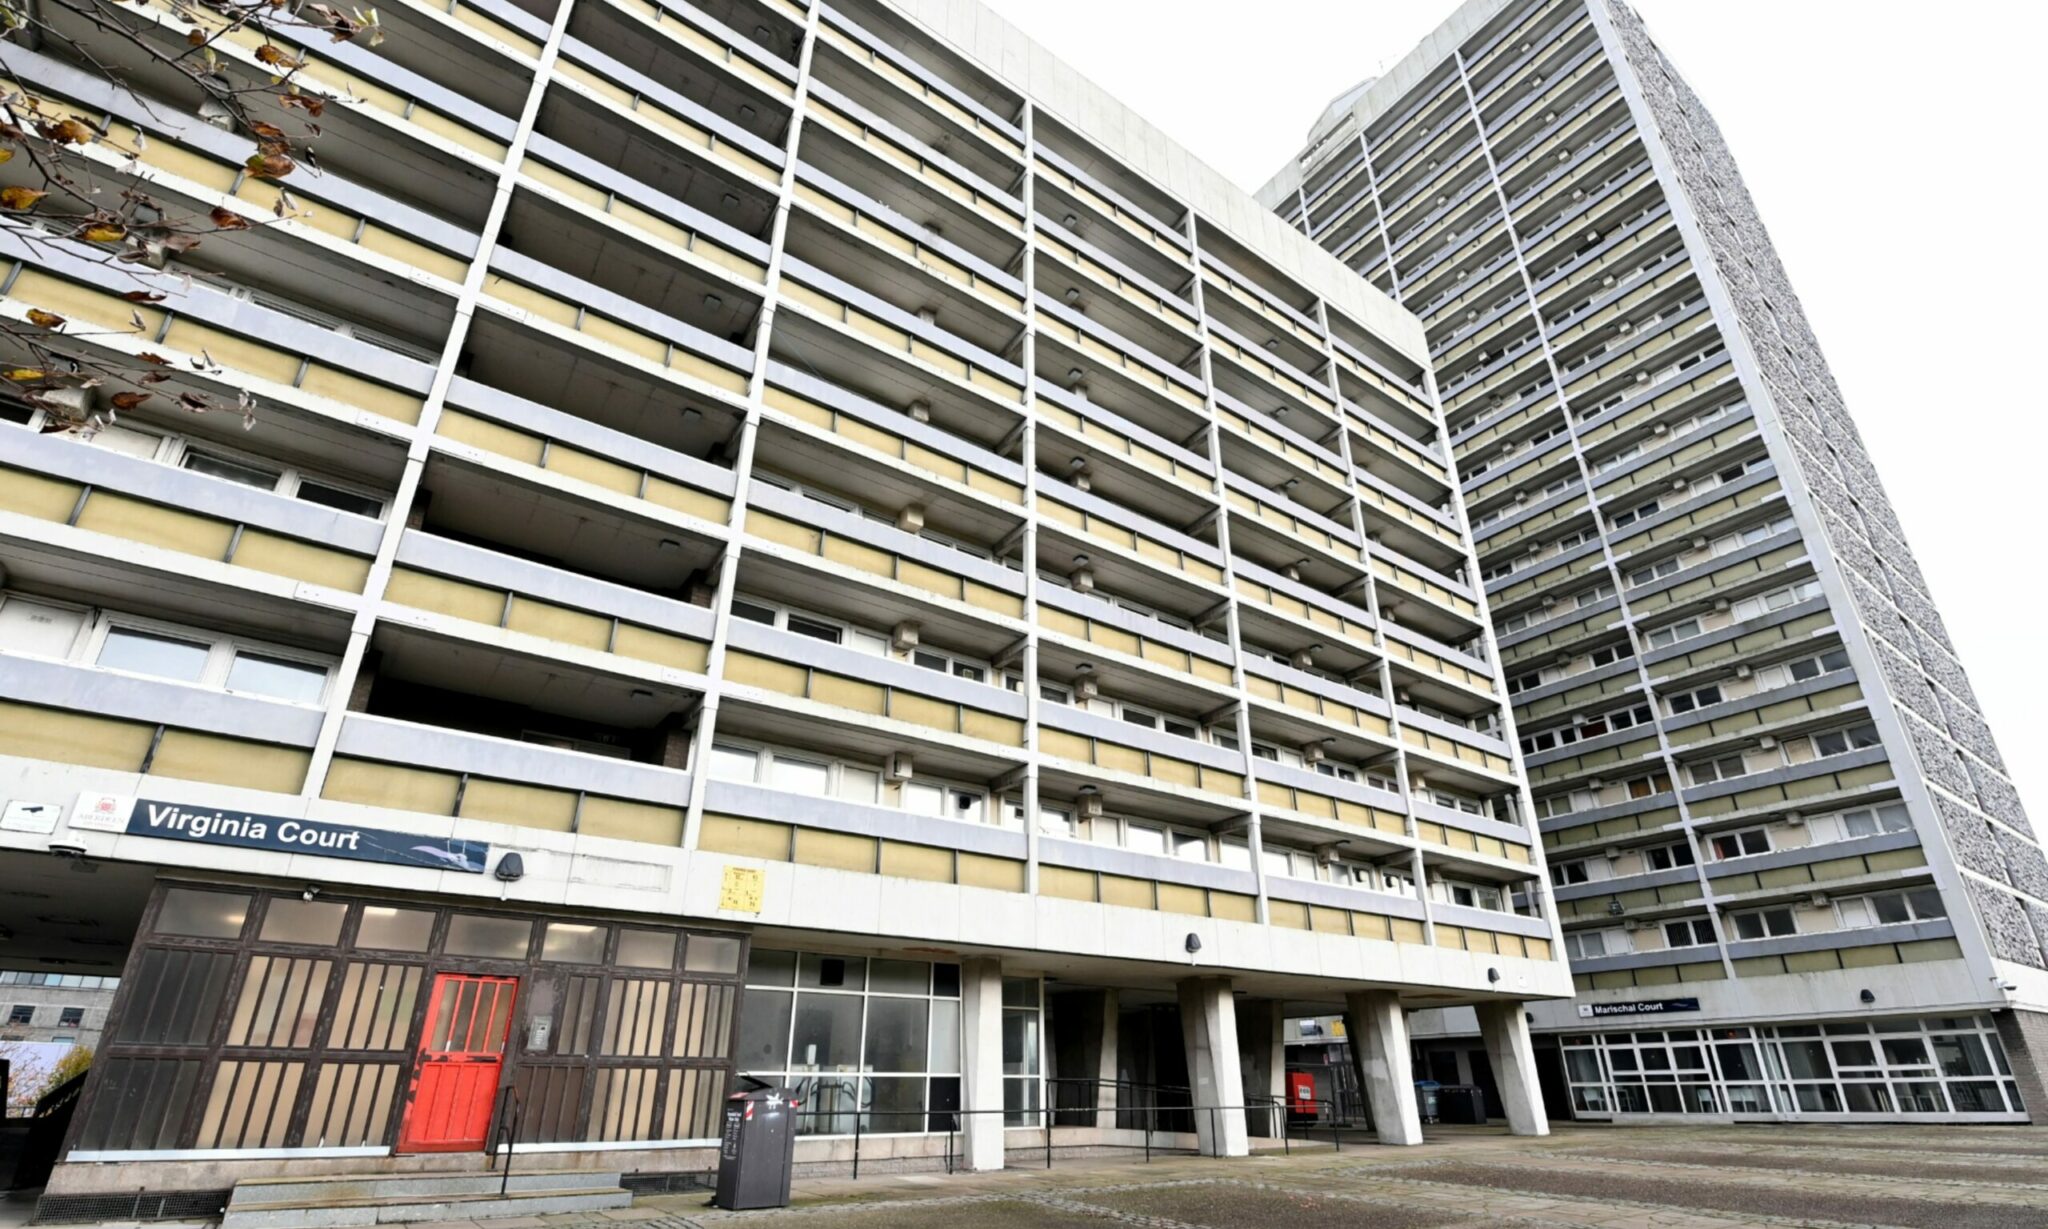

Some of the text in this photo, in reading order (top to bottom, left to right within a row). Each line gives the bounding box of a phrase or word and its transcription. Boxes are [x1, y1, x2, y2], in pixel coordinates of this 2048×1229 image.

[148, 804, 360, 850] Virginia Court
[1595, 1002, 1664, 1014] Marischal Court
